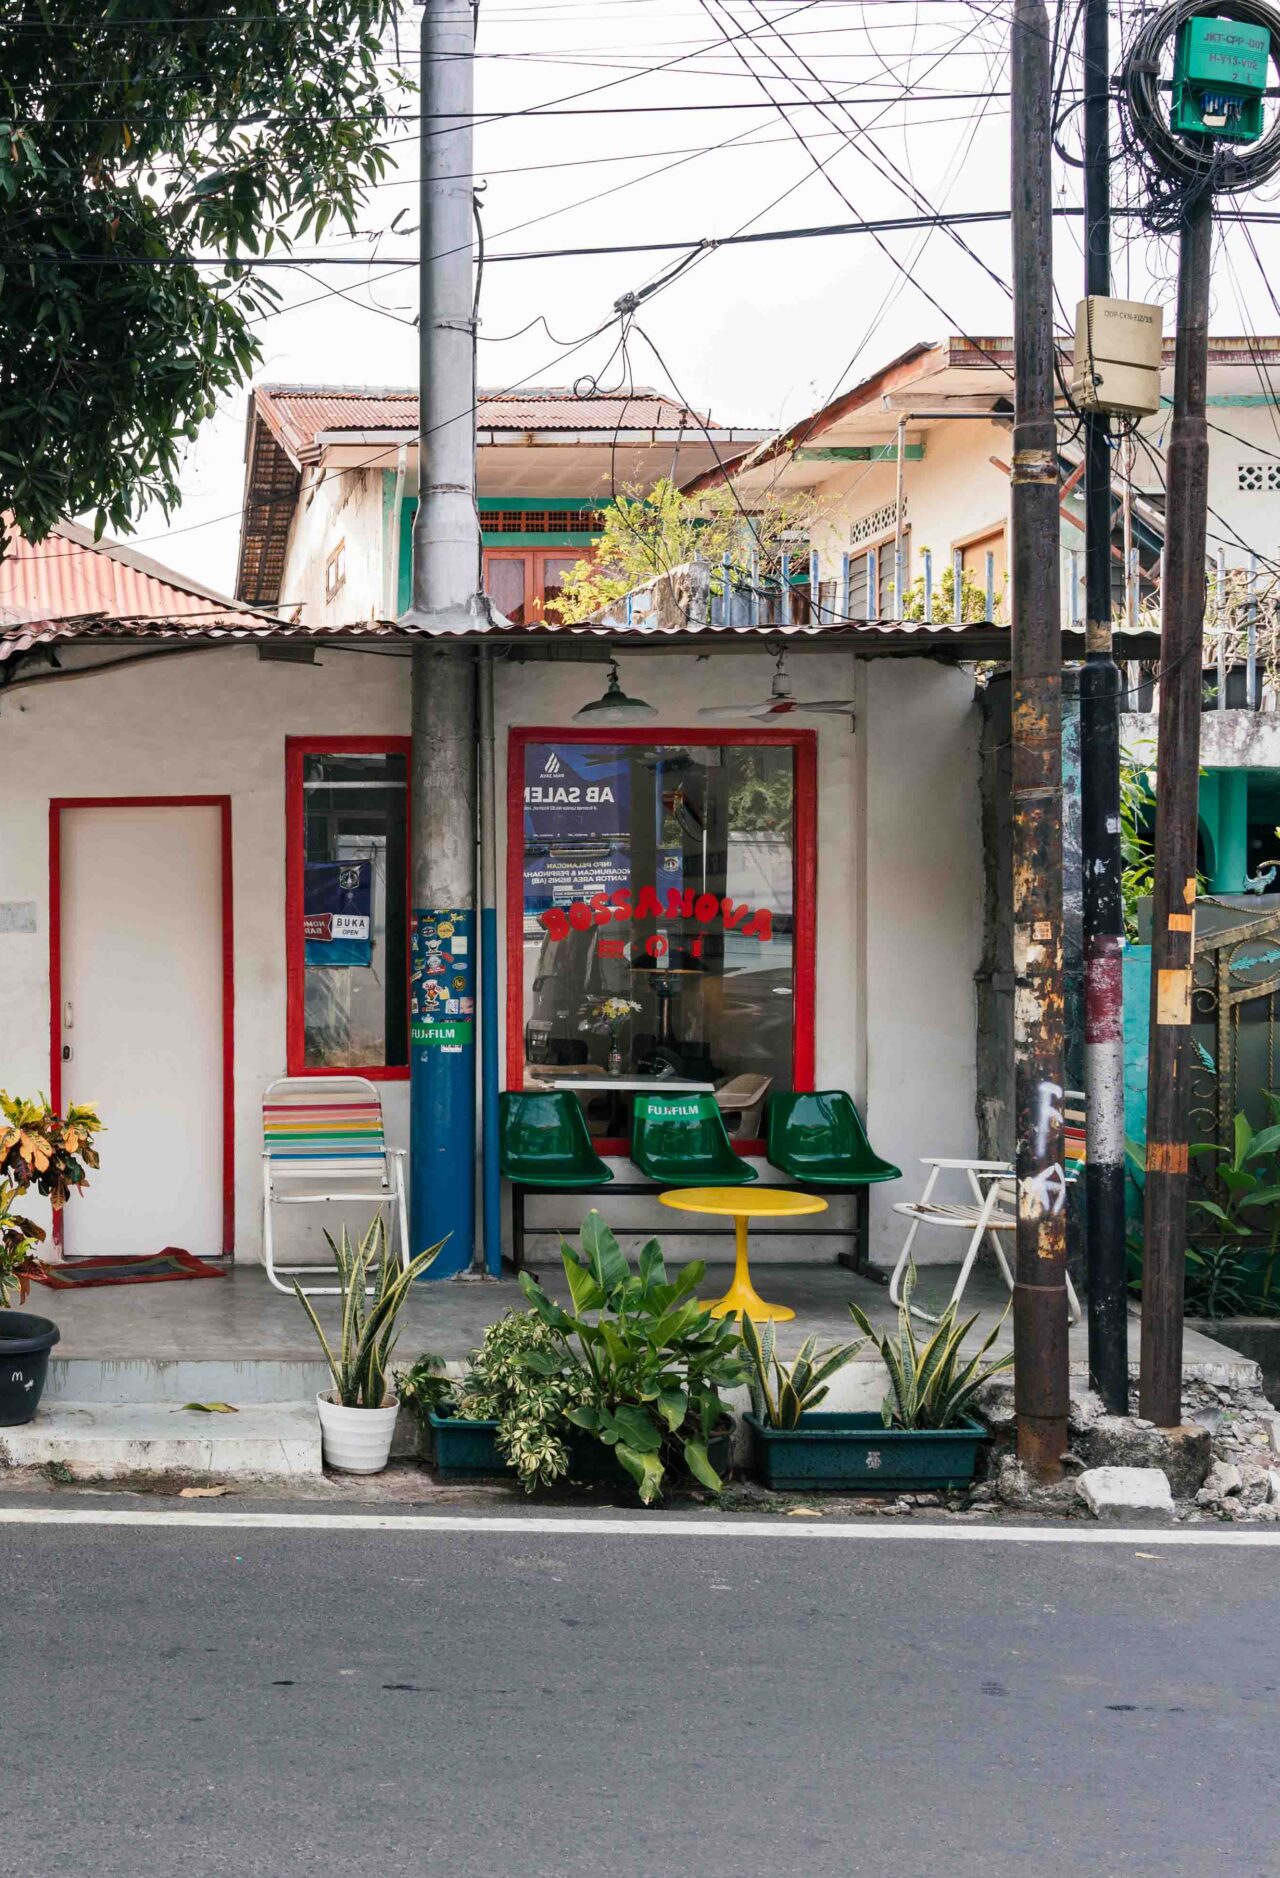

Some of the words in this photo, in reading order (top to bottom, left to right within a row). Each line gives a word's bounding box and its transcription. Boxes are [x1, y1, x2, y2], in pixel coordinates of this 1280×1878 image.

[336, 918, 365, 928] BUKA
[411, 1028, 455, 1039] FUJIFILM
[648, 1104, 699, 1116] FUJIFILM
